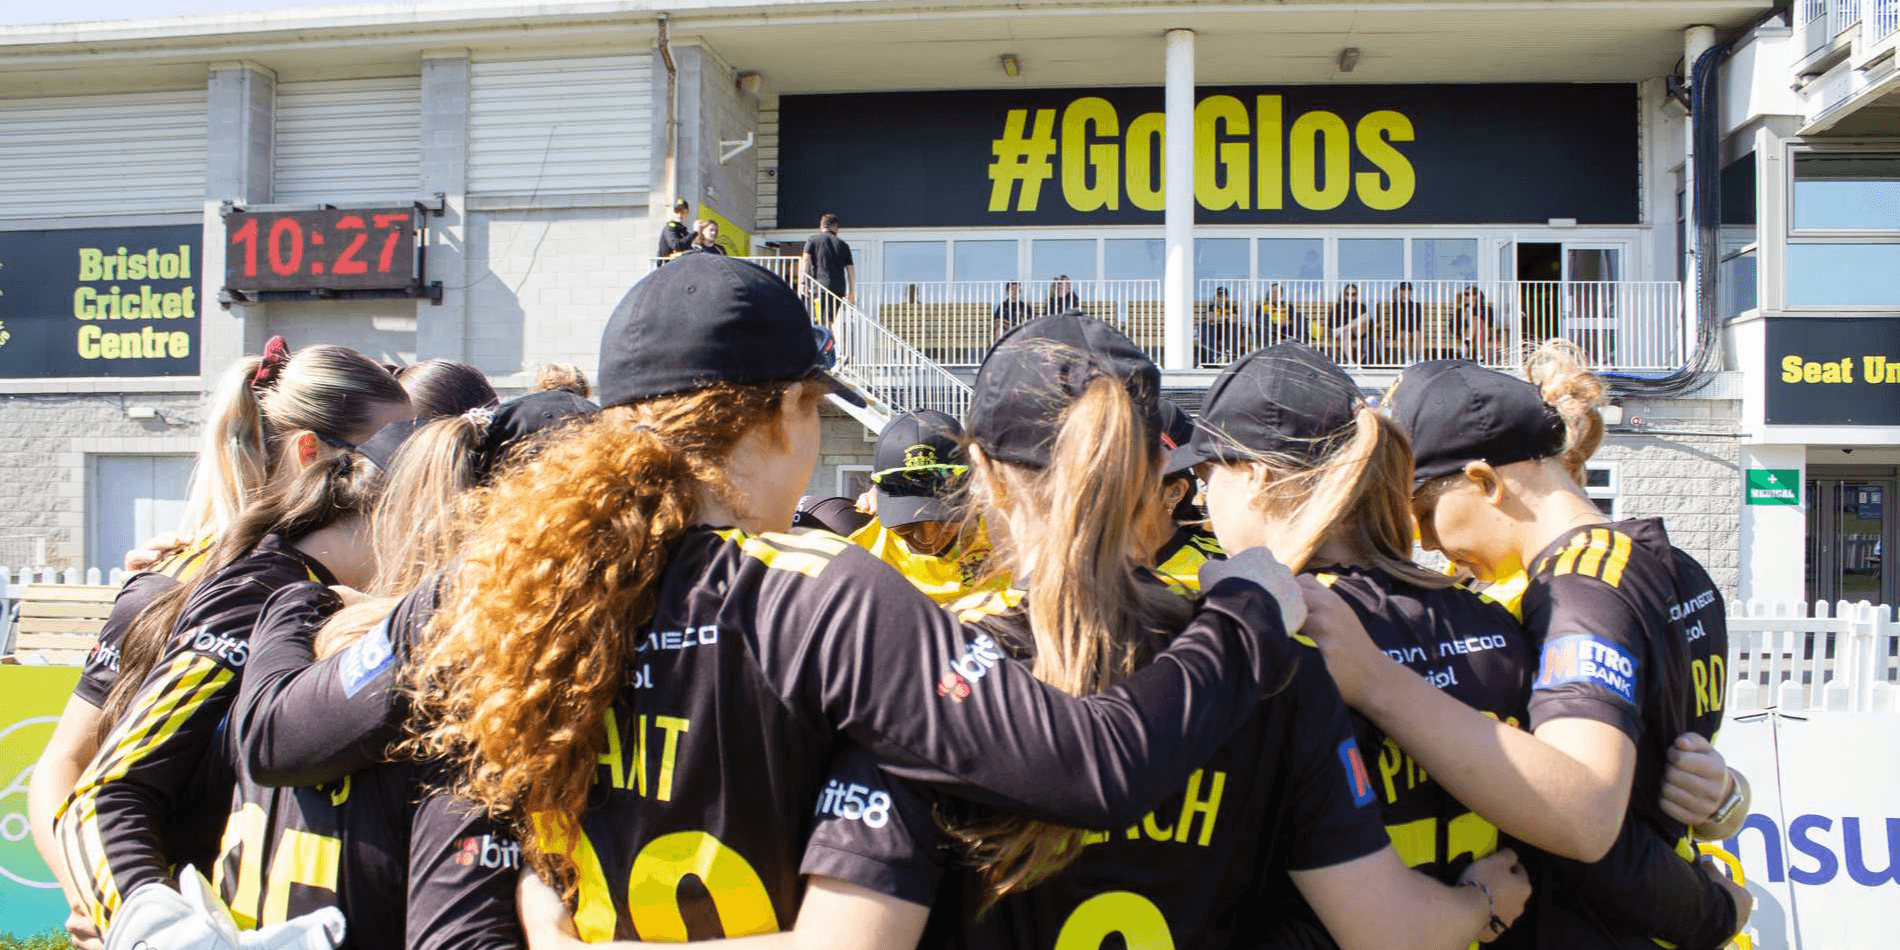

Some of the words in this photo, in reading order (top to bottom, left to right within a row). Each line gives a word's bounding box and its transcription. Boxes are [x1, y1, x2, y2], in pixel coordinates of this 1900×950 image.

[988, 94, 1416, 212] #GoGlos
[79, 244, 191, 281] Bristol
[232, 213, 410, 278] 10:27
[74, 285, 196, 321] Cricket
[77, 324, 191, 360] Centre
[1781, 355, 1854, 384] Seat
[1862, 356, 1900, 384] Un
[1542, 640, 1633, 685] METRO
[1579, 660, 1632, 698] BANK
[815, 779, 892, 829] it58
[1700, 813, 1900, 887] nsu
